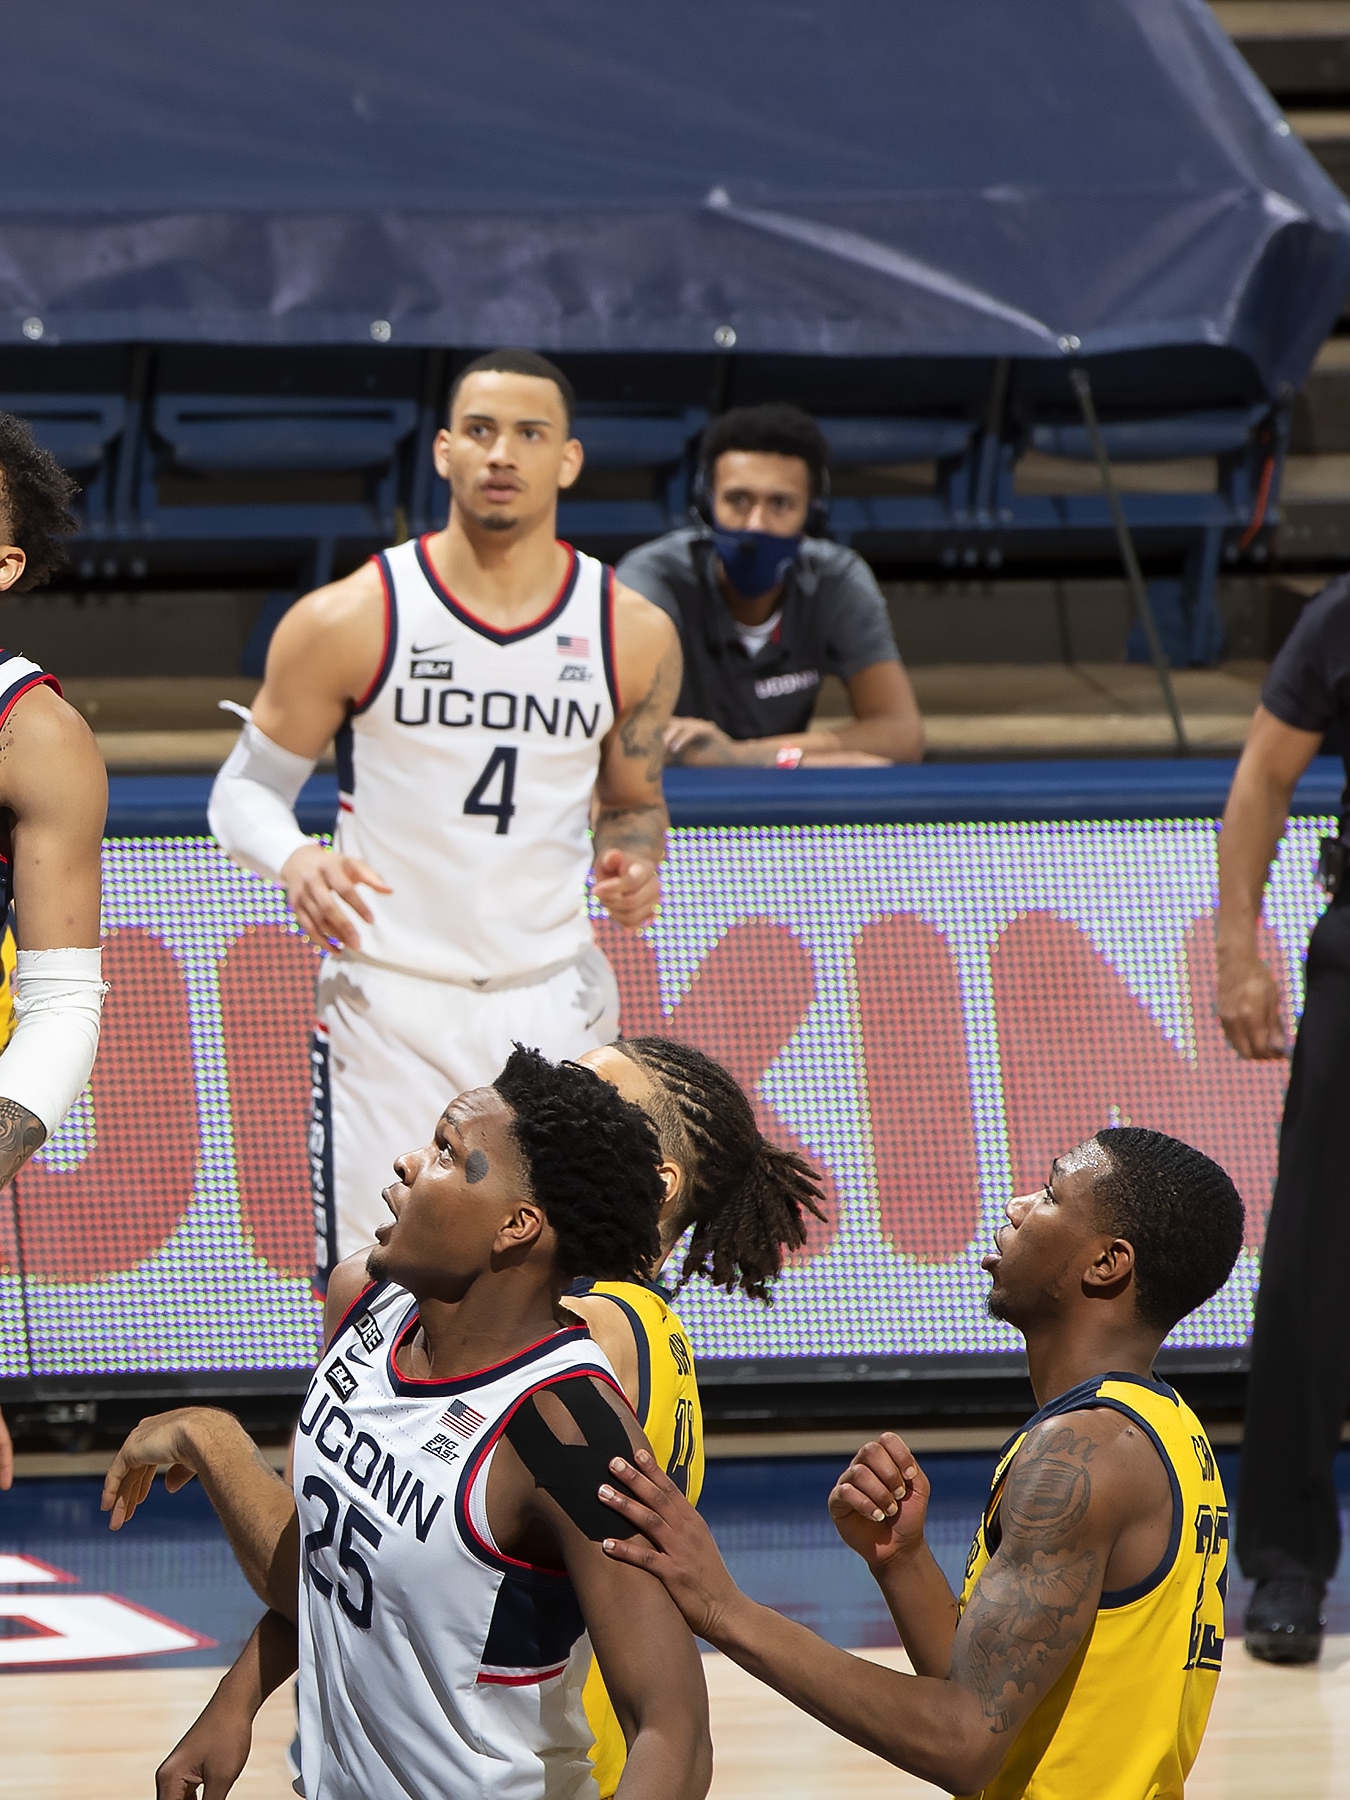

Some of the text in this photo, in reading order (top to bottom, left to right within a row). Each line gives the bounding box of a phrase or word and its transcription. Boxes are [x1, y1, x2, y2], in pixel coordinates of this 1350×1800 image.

[394, 687, 601, 739] UCONN
[463, 745, 518, 835] 4
[358, 1316, 382, 1351] DEE
[332, 1363, 356, 1396] BLM
[299, 1378, 446, 1543] UCONN
[425, 1440, 460, 1463] EAST
[434, 1433, 459, 1450] BIG
[301, 1474, 383, 1630] 25
